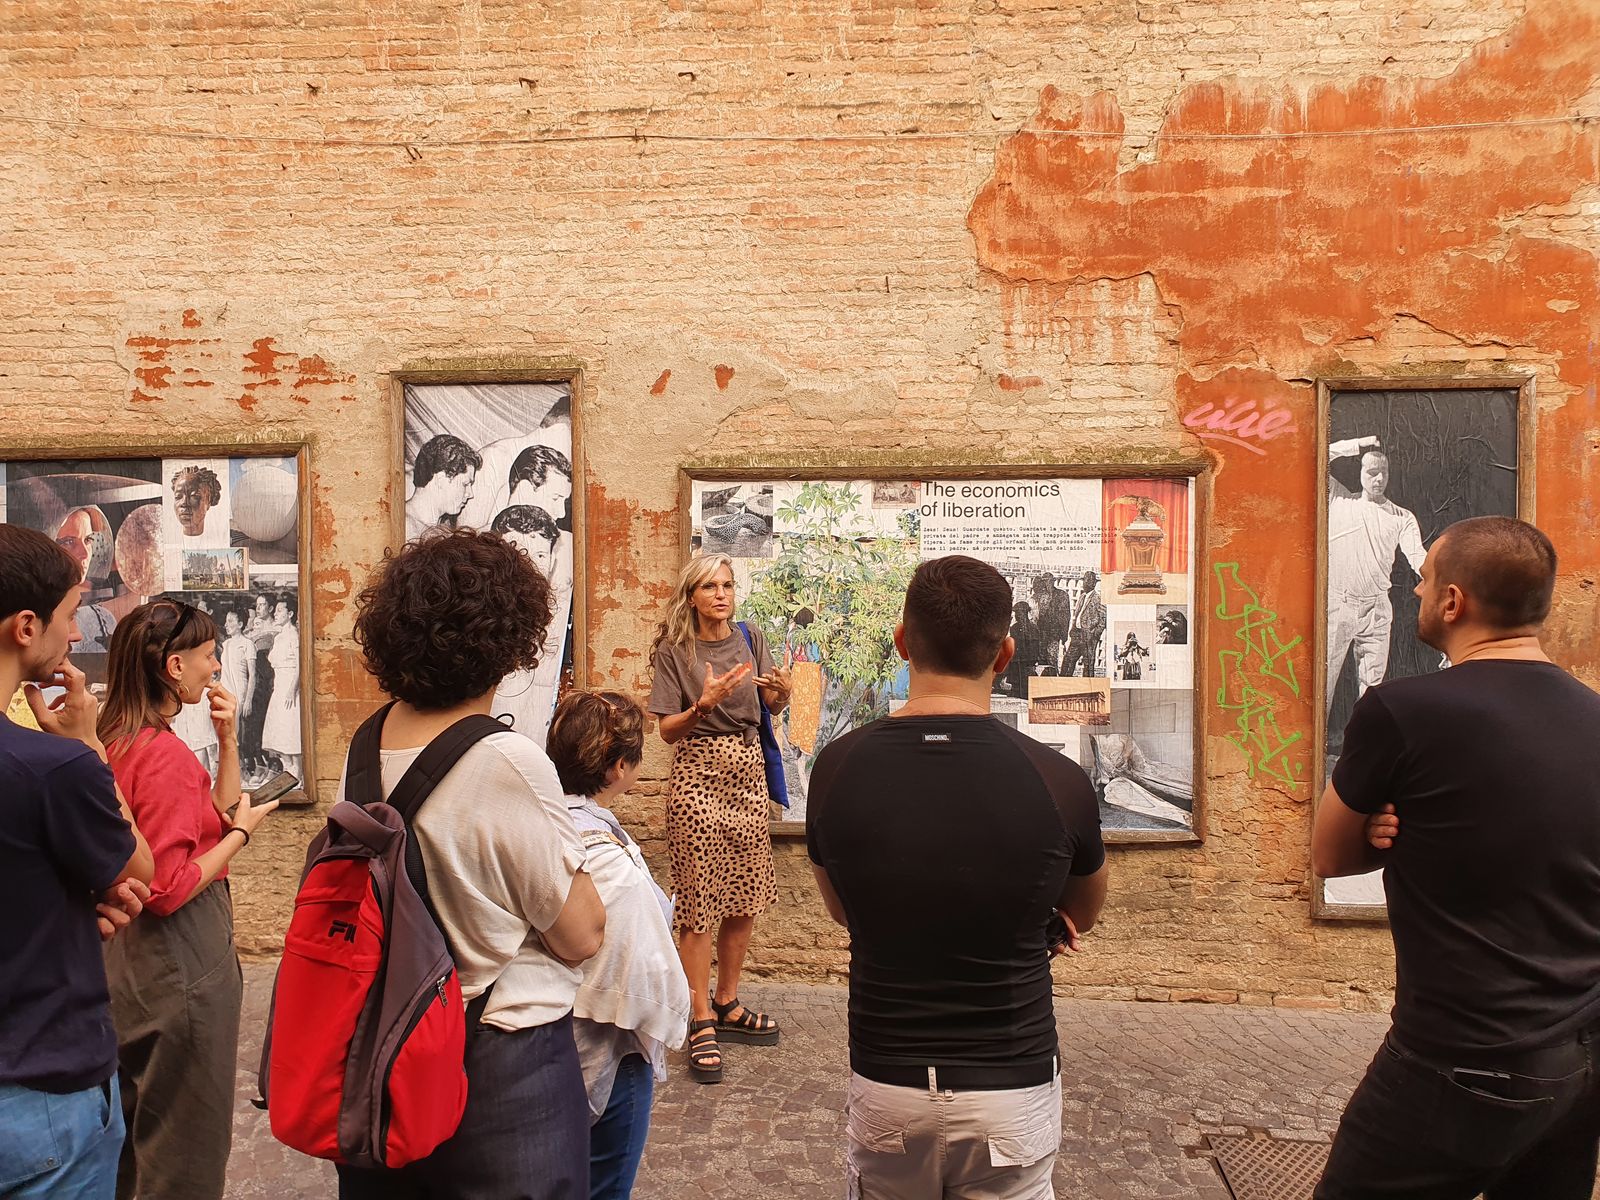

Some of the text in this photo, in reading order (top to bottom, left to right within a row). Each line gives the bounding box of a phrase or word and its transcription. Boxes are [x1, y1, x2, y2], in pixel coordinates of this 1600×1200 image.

[922, 481, 1060, 498] The economics
[921, 501, 1025, 518] of liberation
